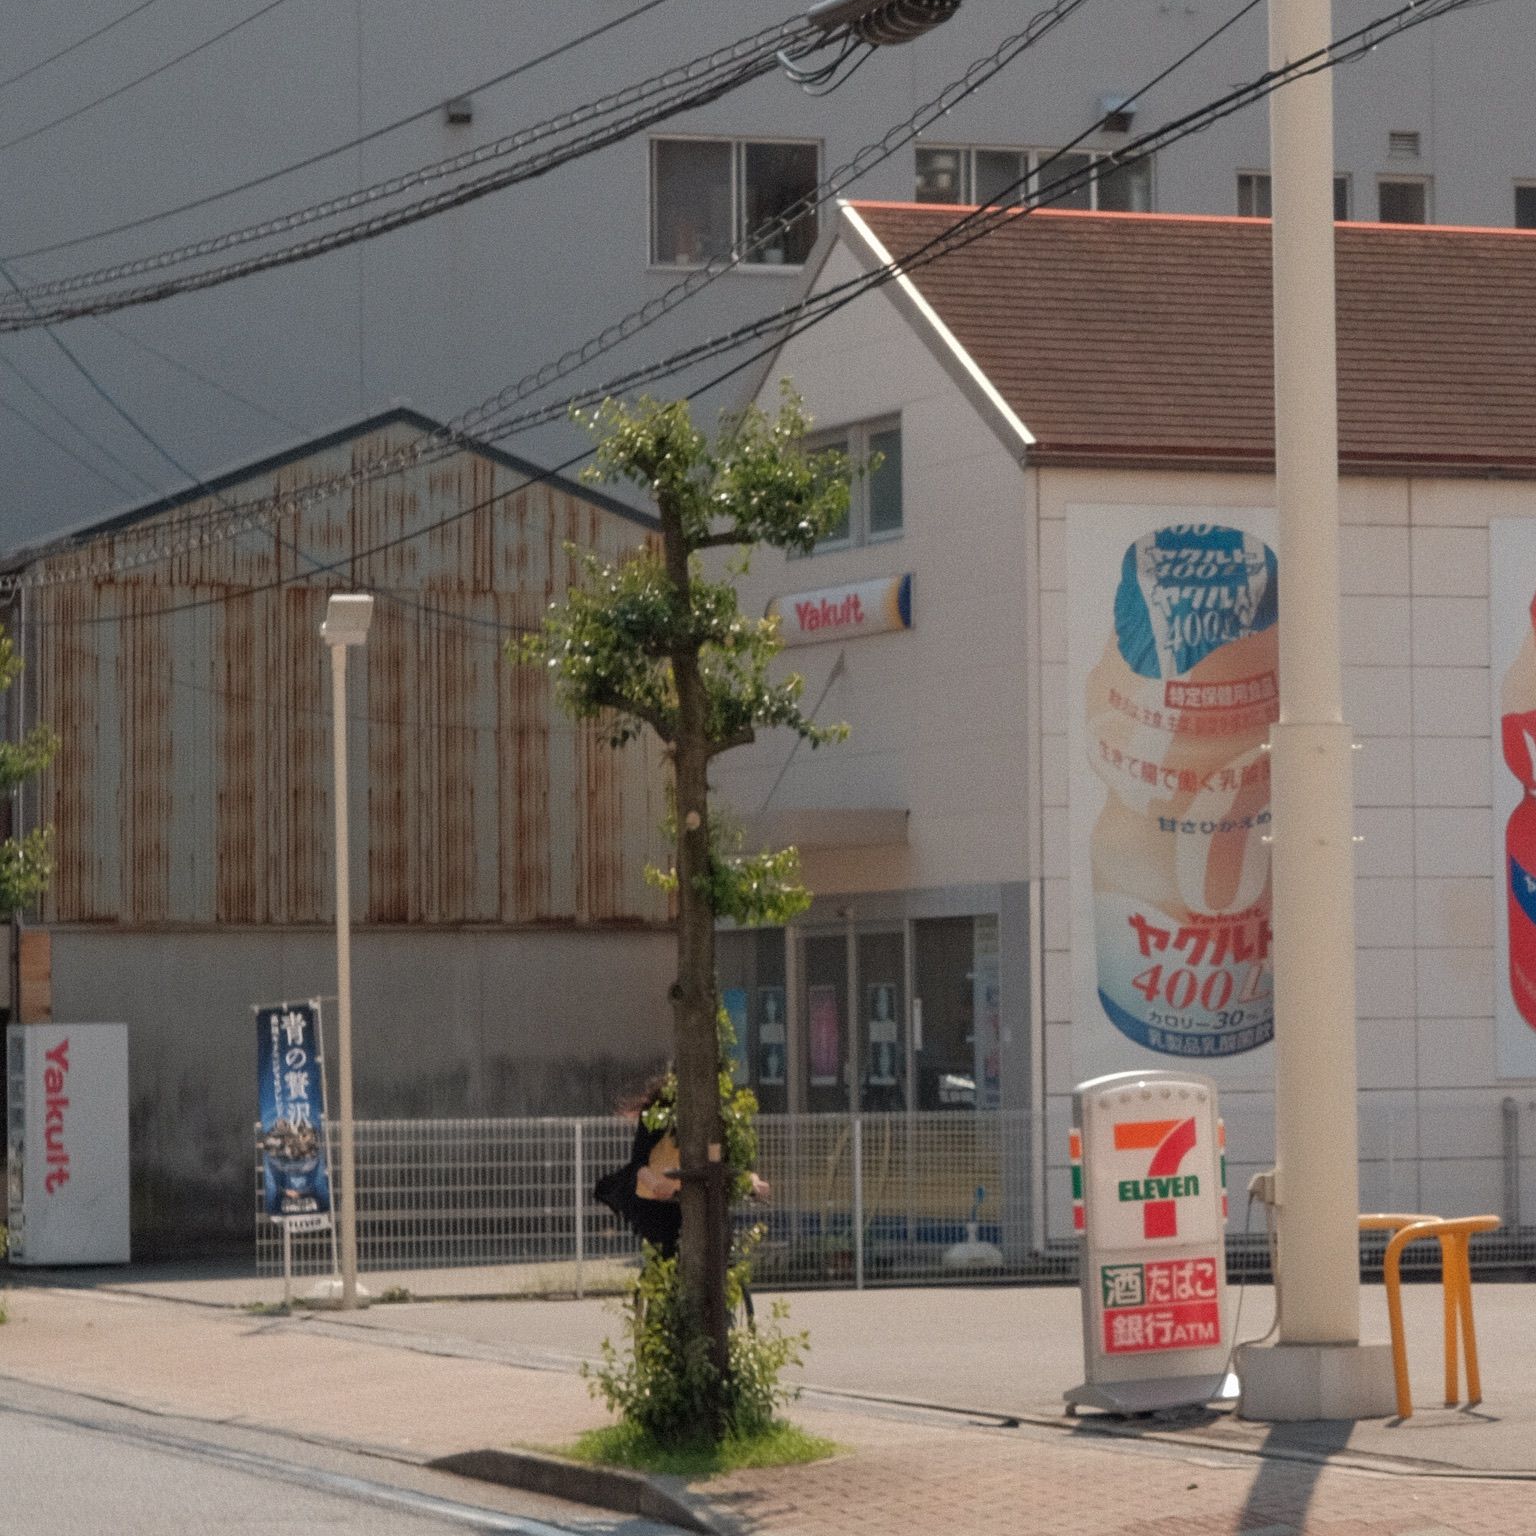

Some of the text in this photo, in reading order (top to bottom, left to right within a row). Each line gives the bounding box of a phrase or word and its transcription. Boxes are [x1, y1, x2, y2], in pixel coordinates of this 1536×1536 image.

[795, 593, 865, 631] Yakult
[1158, 811, 1272, 835] 甘さひかえめ
[1128, 911, 1273, 967] ヤクルト
[1131, 964, 1234, 1012] 400
[43, 1036, 70, 1196] Yakult
[1107, 1267, 1142, 1306] 酒
[1149, 1263, 1216, 1302] たばこ
